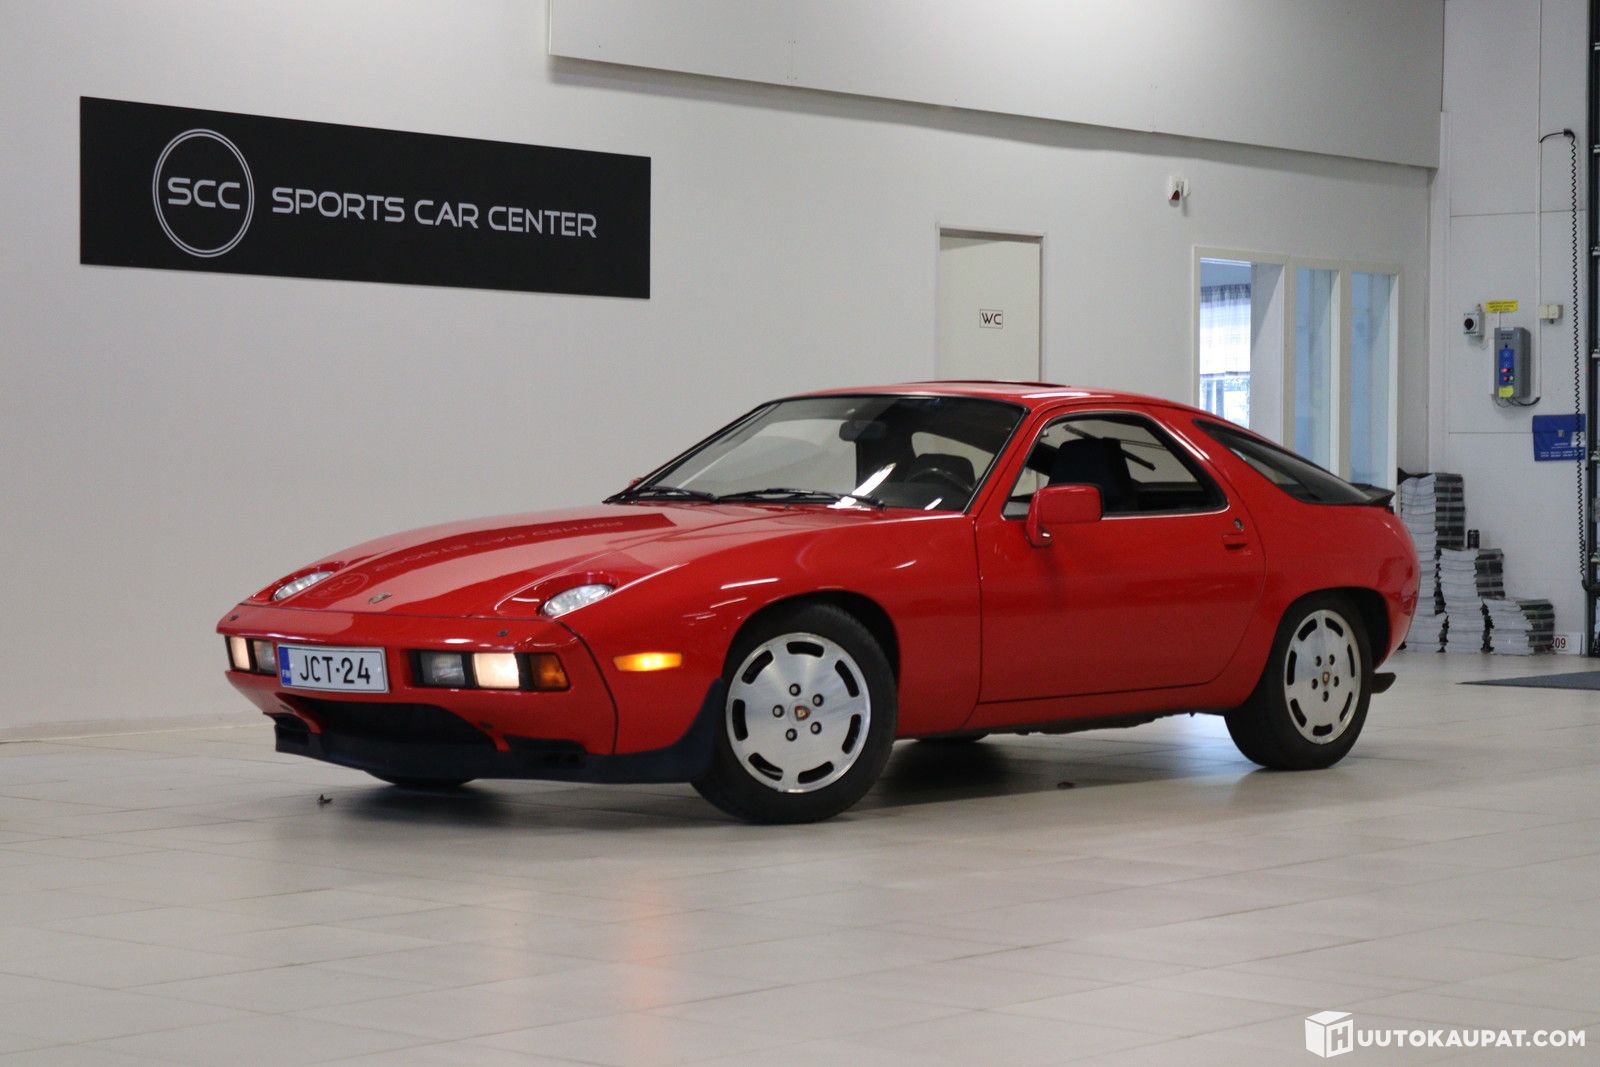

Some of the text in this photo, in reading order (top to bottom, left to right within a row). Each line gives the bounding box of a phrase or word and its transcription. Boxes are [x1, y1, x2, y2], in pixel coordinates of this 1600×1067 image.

[168, 177, 241, 210] SCC
[272, 187, 597, 239] SPORTS CAR CENTER
[981, 312, 1002, 326] WC
